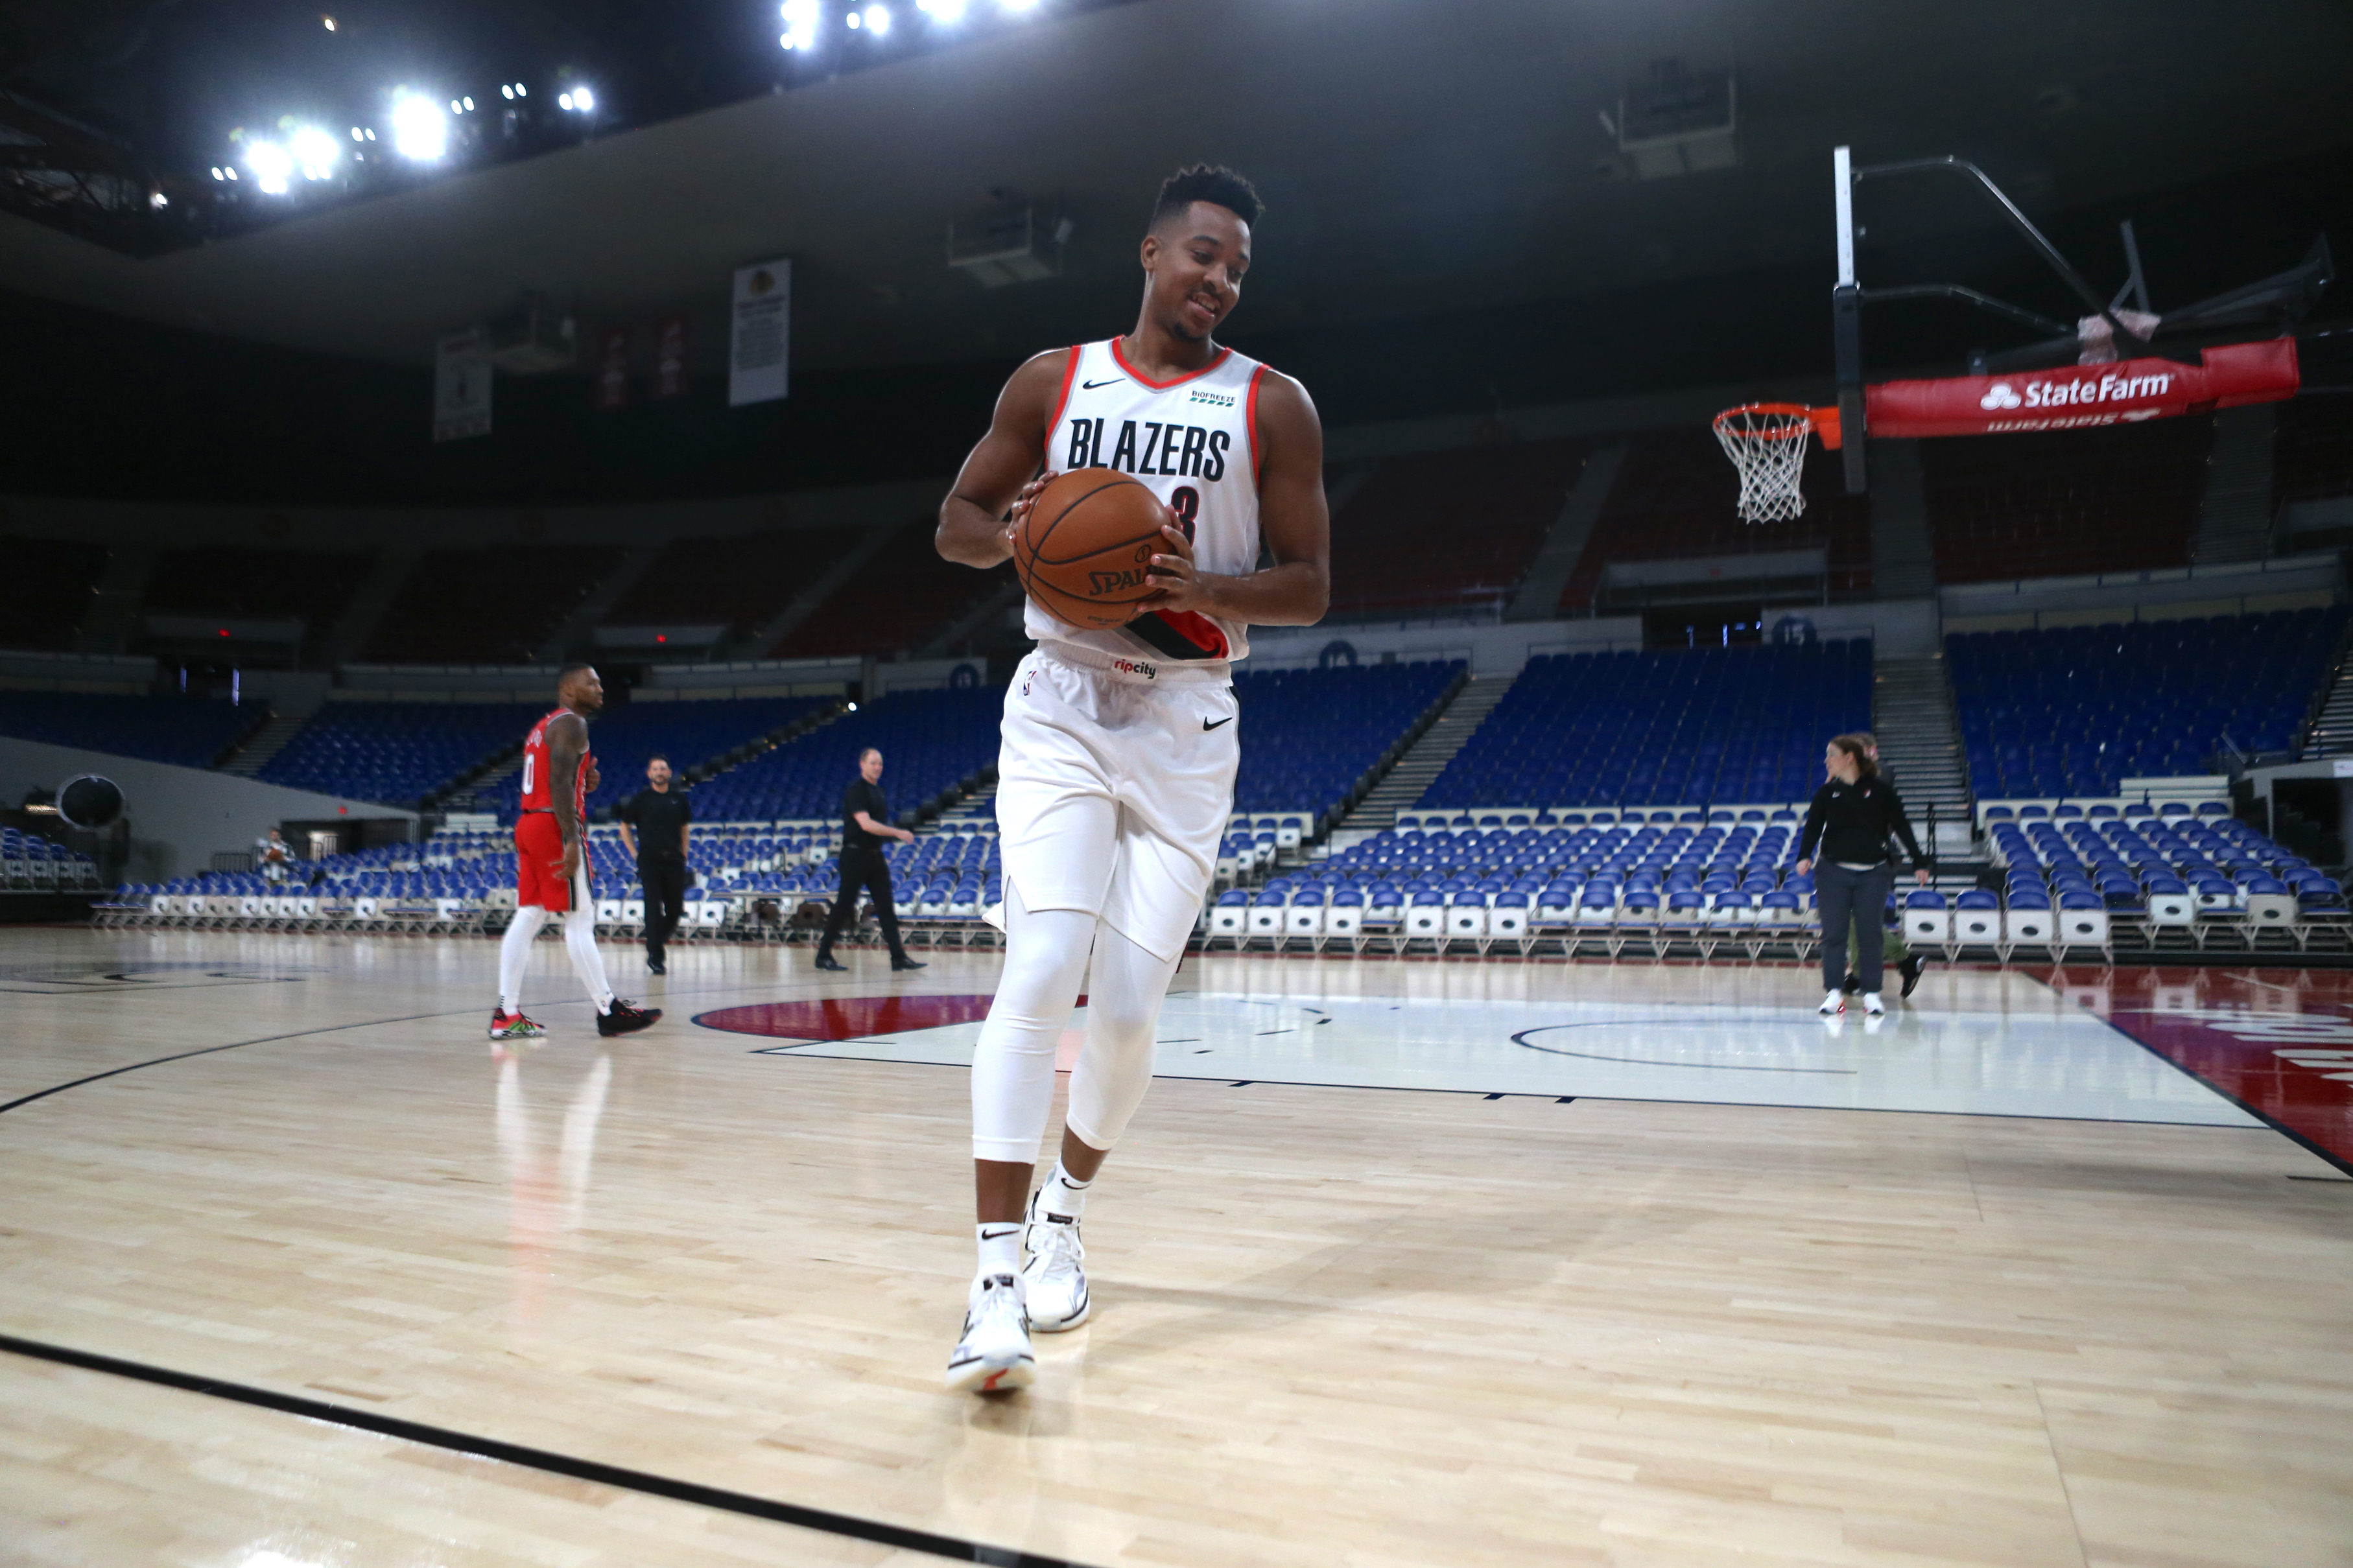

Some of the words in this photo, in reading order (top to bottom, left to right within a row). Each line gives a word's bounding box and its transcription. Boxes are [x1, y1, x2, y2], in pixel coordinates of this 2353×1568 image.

[2024, 377, 2098, 408] State
[2098, 372, 2170, 403] Farm
[1067, 417, 1231, 482] BLAZERS
[1088, 565, 1166, 596] SPAL
[1114, 659, 1156, 679] ripcity
